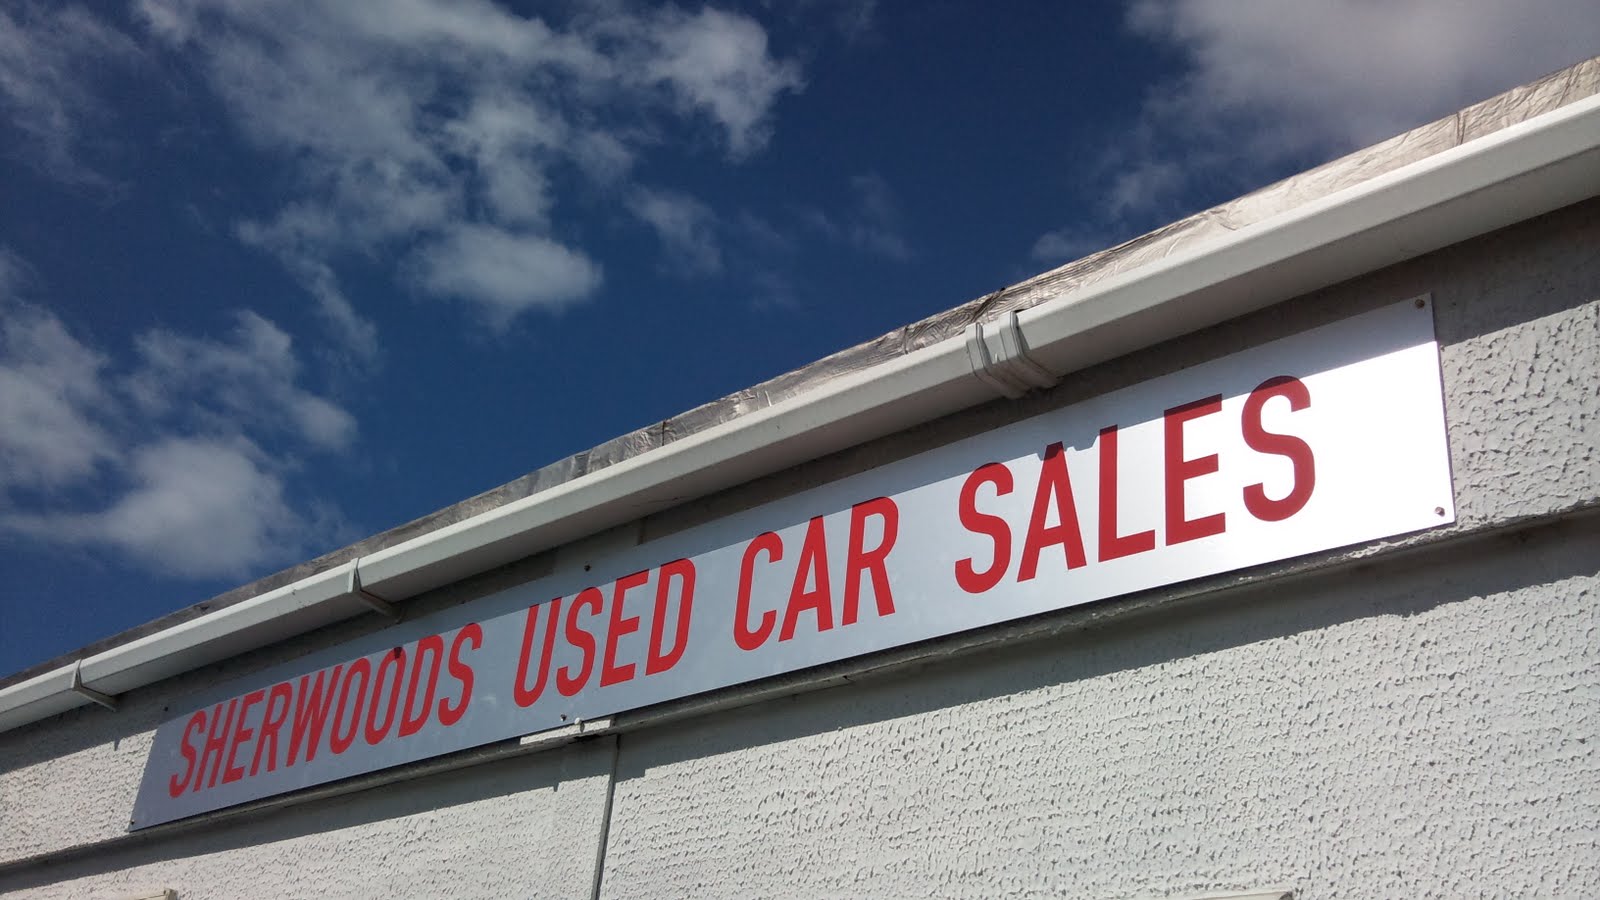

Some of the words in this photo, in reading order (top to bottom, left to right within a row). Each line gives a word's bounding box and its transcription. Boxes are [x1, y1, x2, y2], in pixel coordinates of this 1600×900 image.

[168, 622, 483, 798] SHERWOODS
[514, 557, 697, 708] USED
[733, 495, 900, 652] CAR
[954, 374, 1317, 595] SALES
